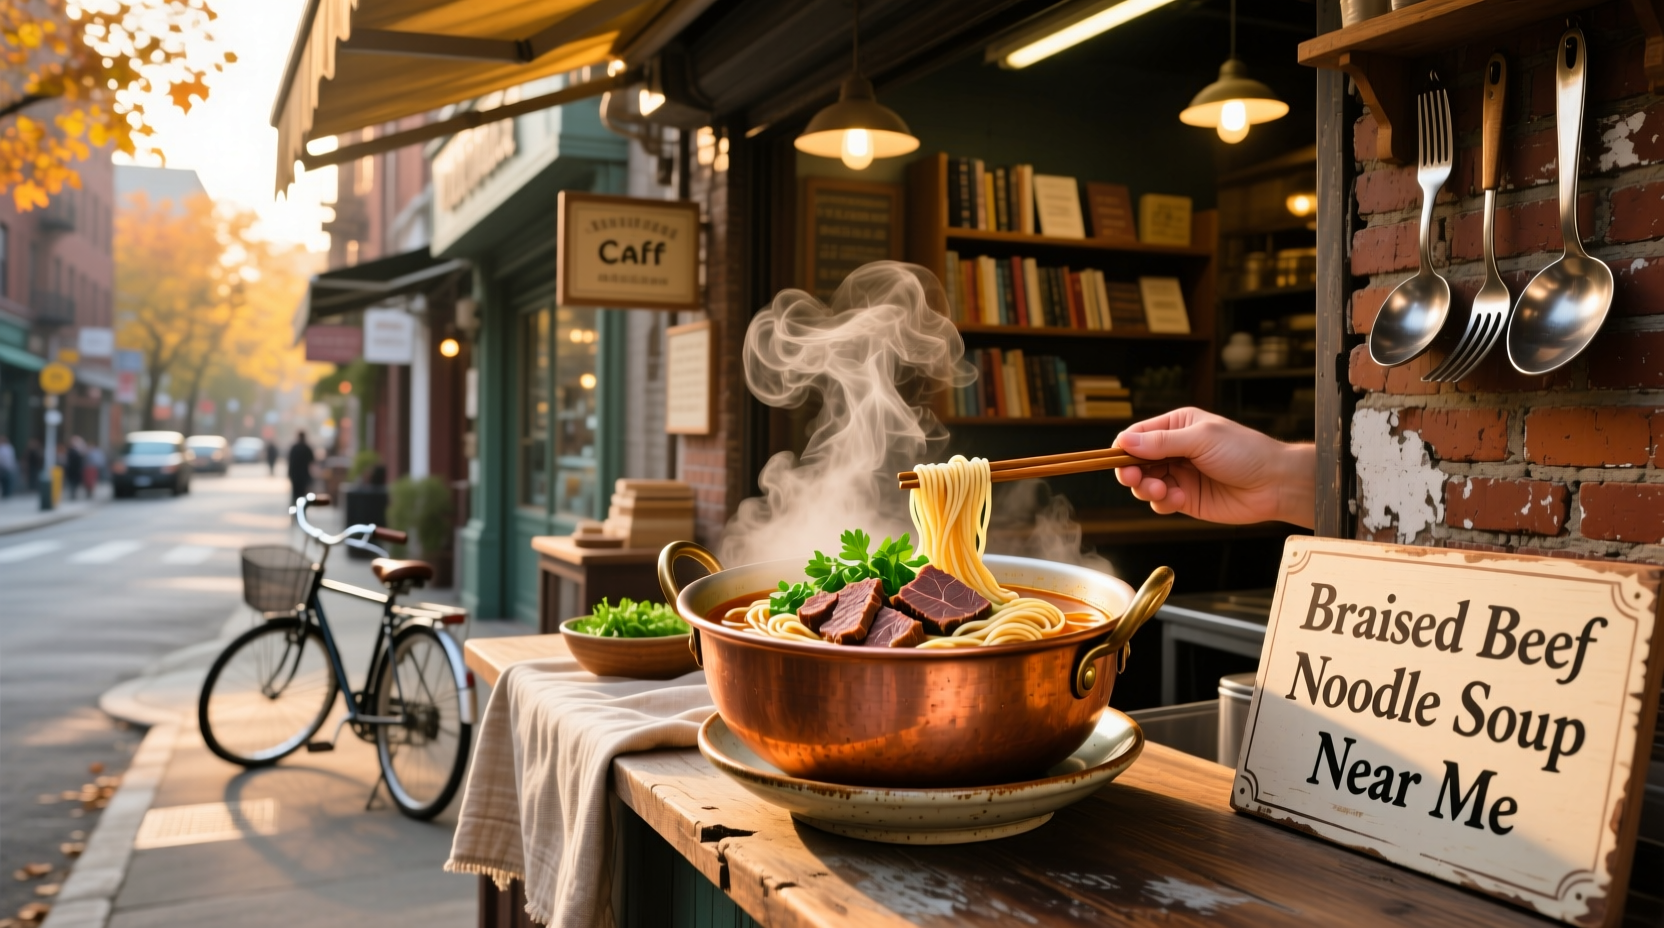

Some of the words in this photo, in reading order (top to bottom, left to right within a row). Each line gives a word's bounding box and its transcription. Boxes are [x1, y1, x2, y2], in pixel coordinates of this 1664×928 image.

[1299, 582, 1471, 654] Braised
[1475, 604, 1609, 686] Beef
[1284, 651, 1441, 727] Noodle
[1452, 680, 1586, 774] Soup
[1305, 730, 1423, 808] Near
[1427, 759, 1518, 836] Me
